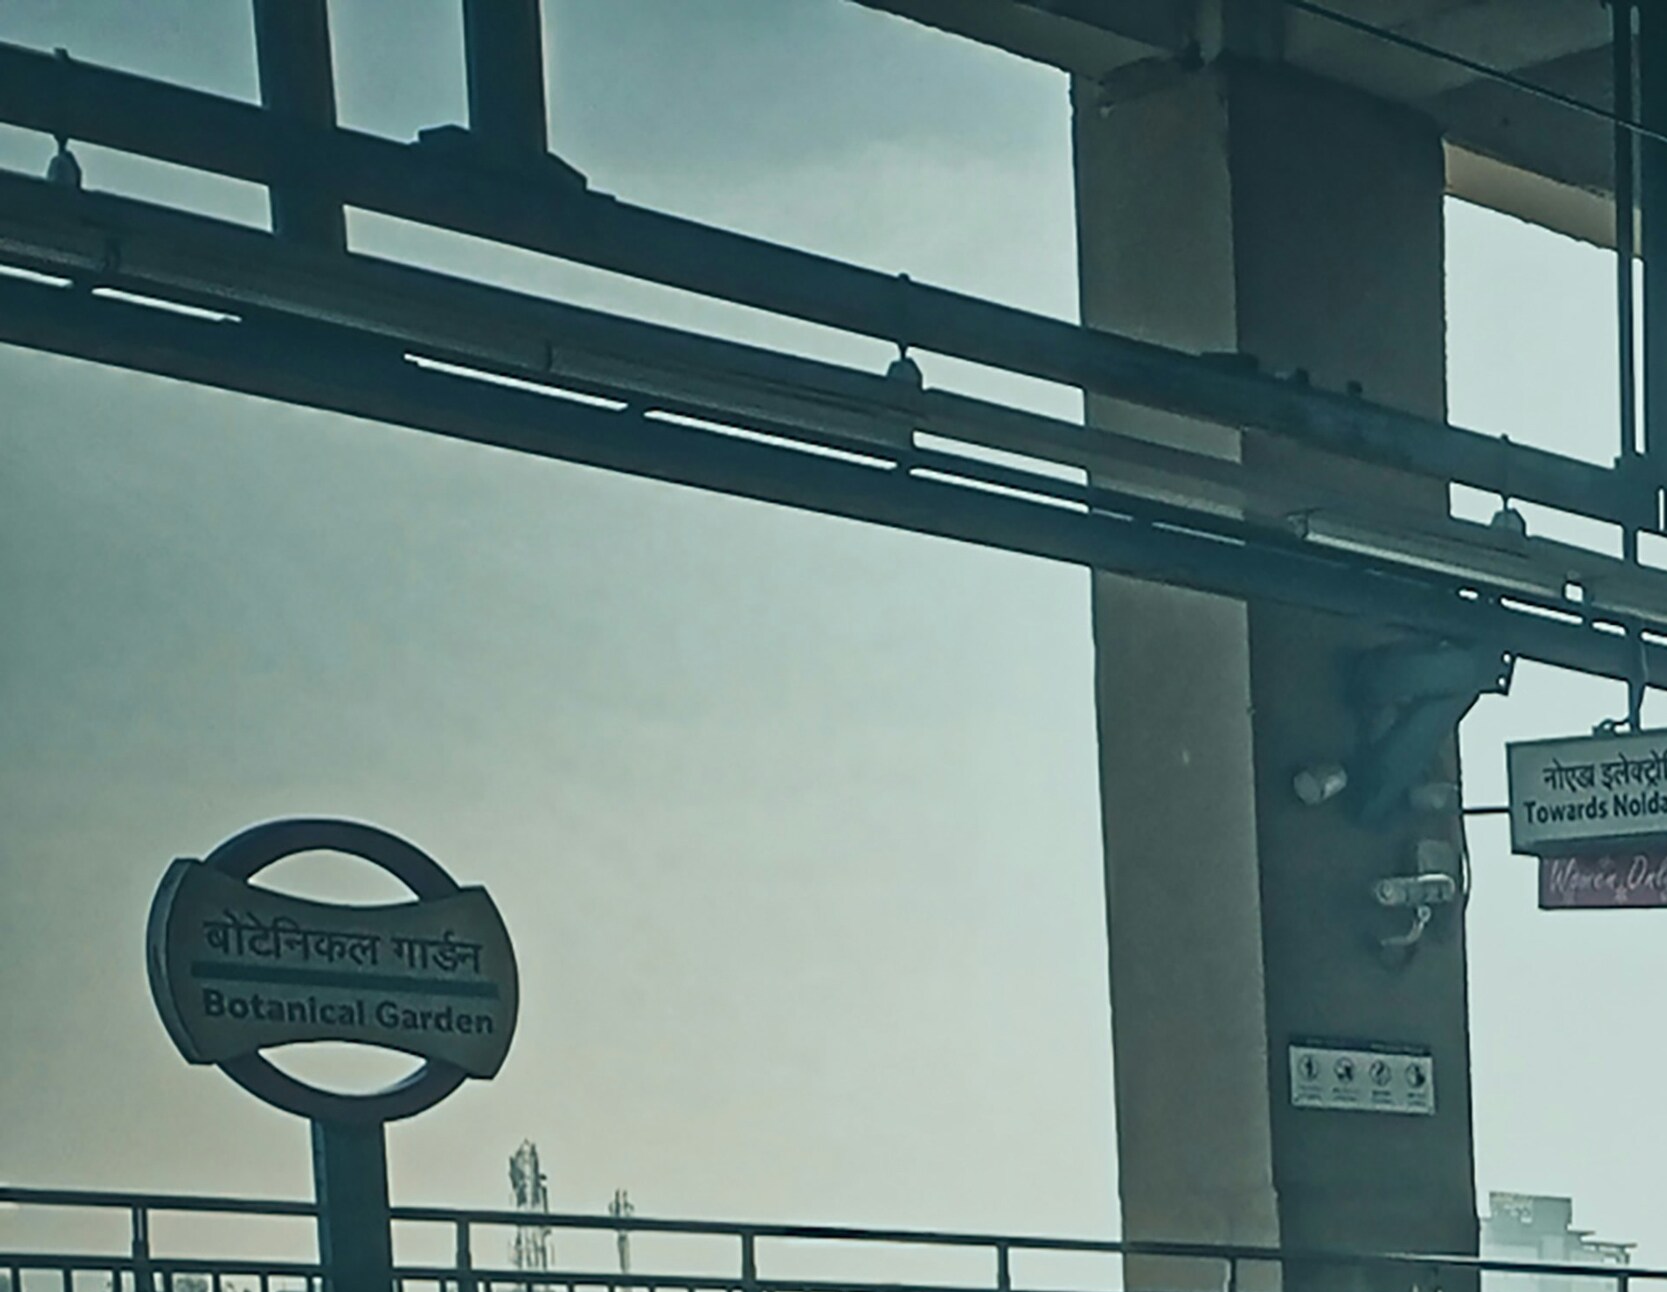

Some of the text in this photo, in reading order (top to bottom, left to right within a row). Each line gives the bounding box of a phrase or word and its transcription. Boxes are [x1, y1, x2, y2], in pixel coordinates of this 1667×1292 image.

[1524, 796, 1609, 825] Towards
[1550, 857, 1618, 893] Women
[392, 930, 482, 974] गार्डन
[203, 988, 494, 1035] Botanical Garden
